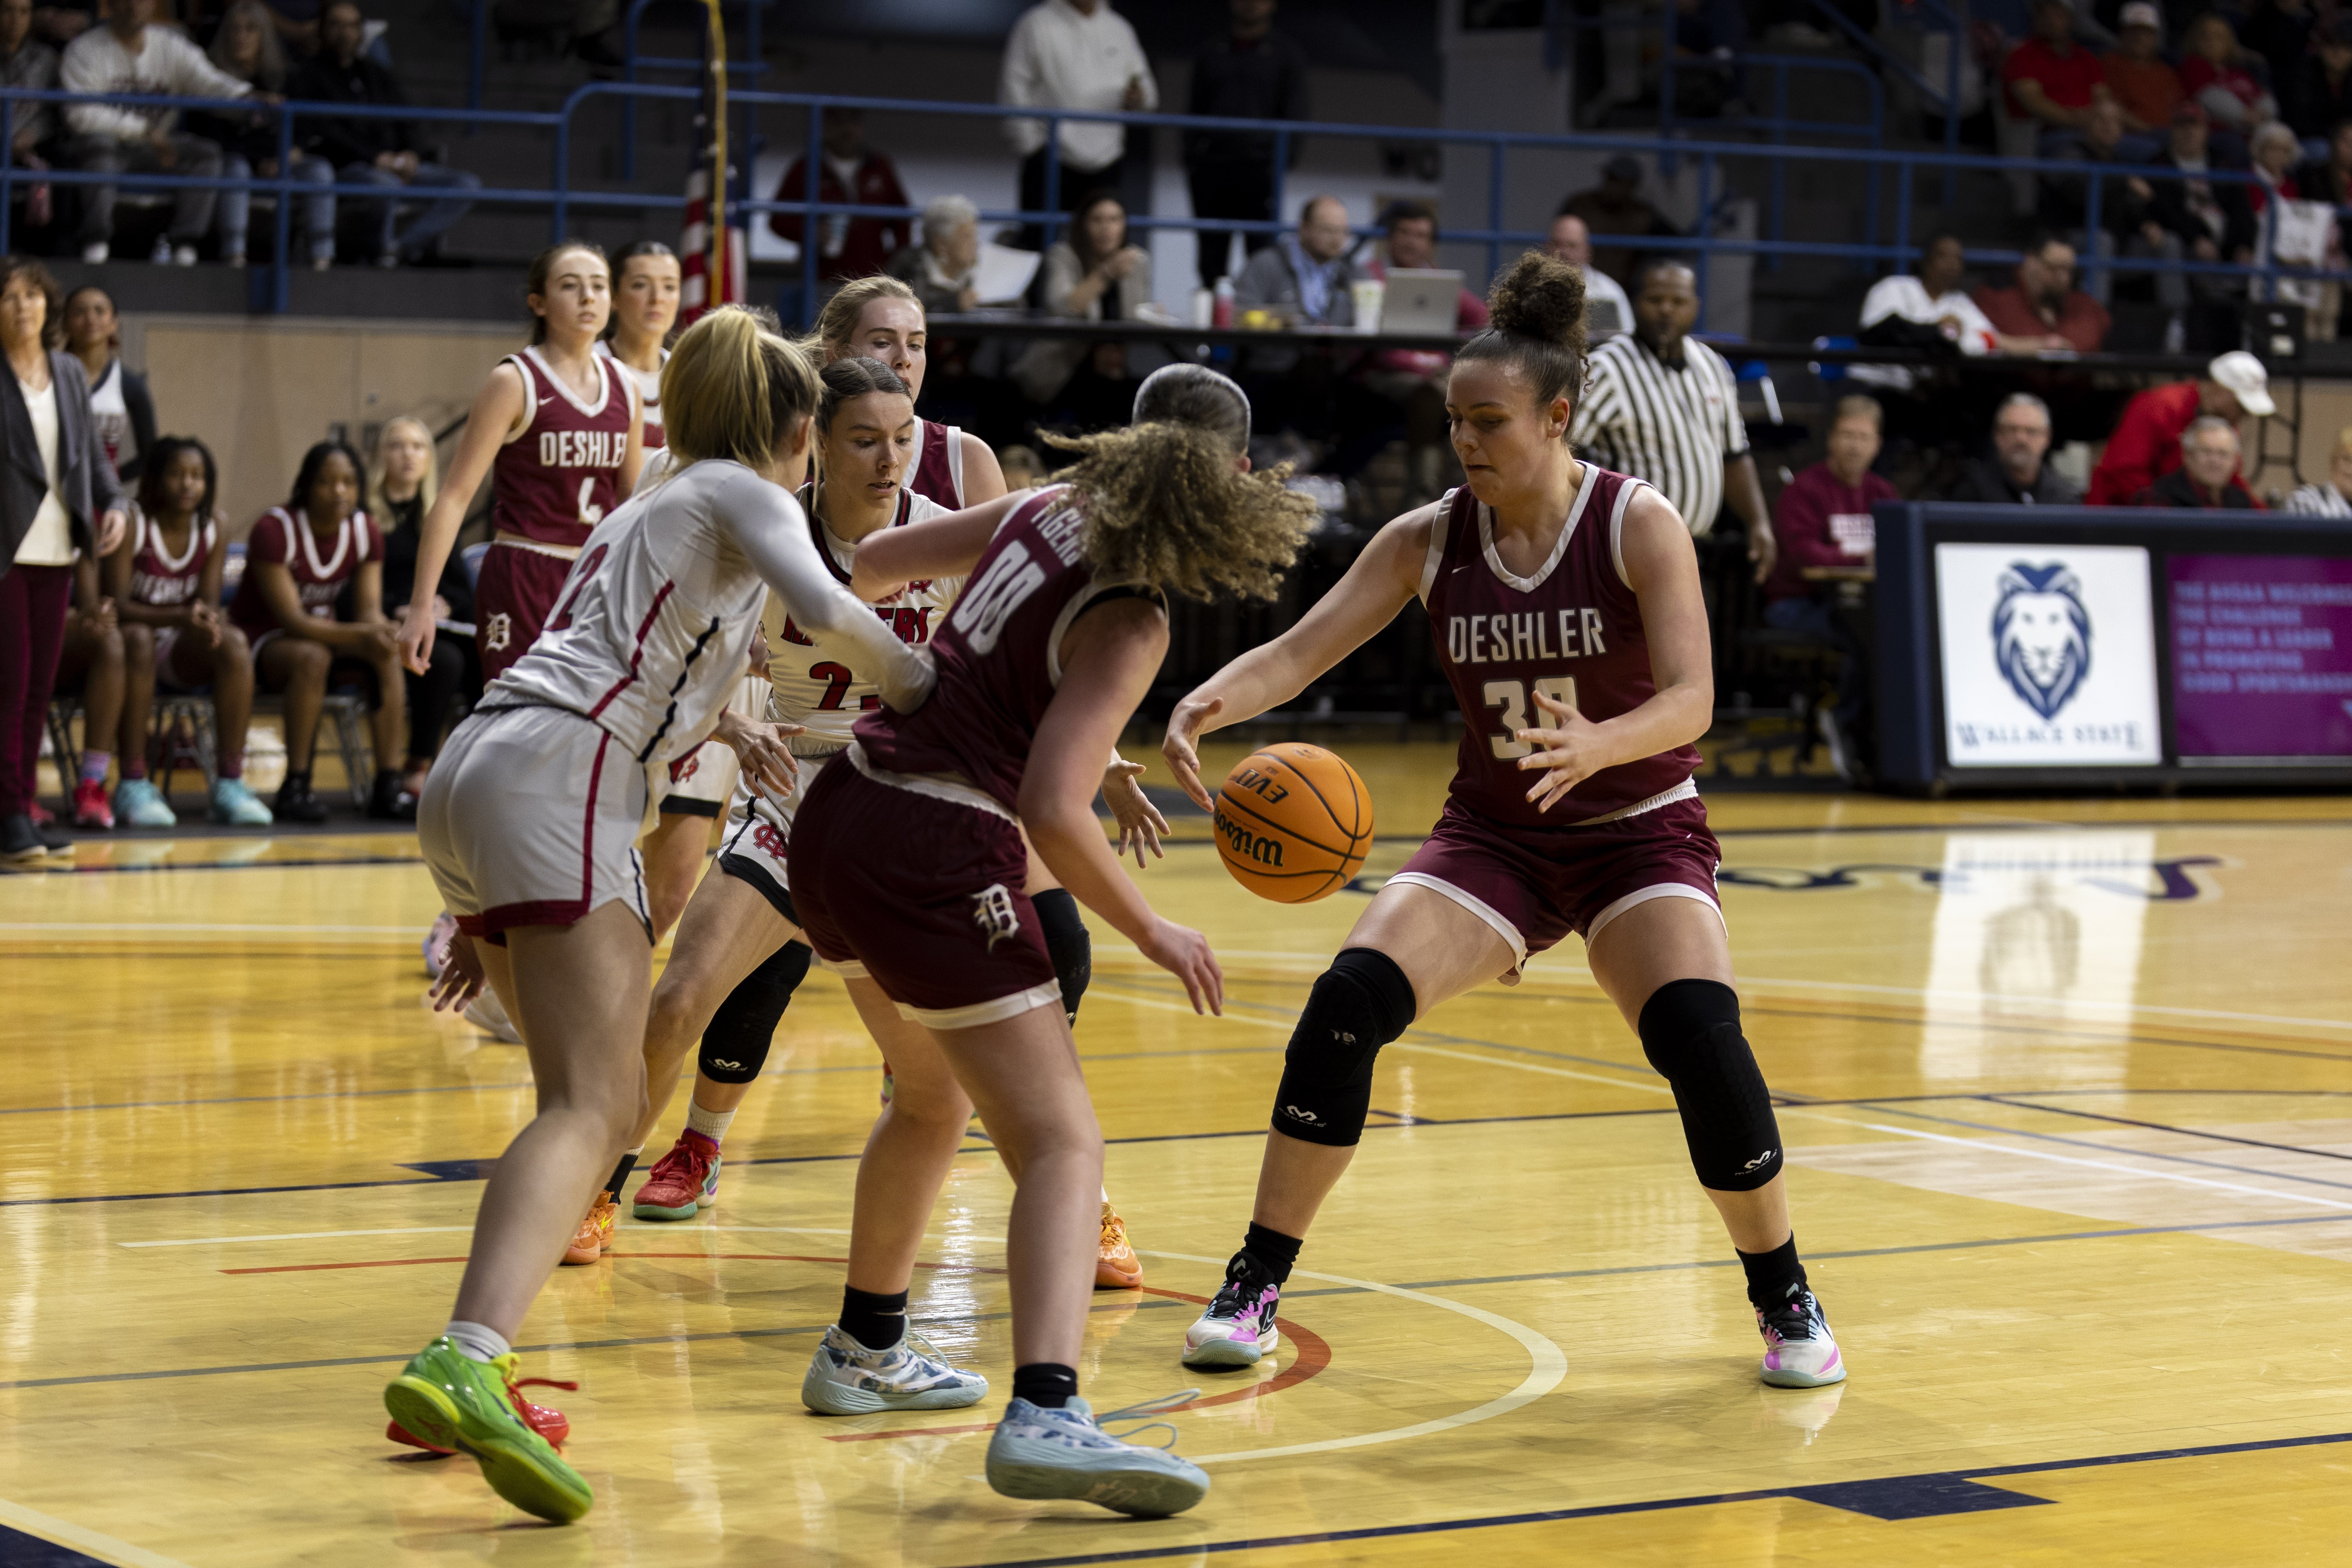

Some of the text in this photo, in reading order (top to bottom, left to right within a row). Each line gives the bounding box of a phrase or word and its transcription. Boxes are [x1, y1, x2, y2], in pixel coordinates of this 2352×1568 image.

[540, 431, 628, 468] DESHLE
[1449, 607, 1607, 664] DESHLER
[1482, 674, 1579, 761] 30
[1236, 768, 1290, 804] EVO
[1213, 806, 1284, 867] Wilson
